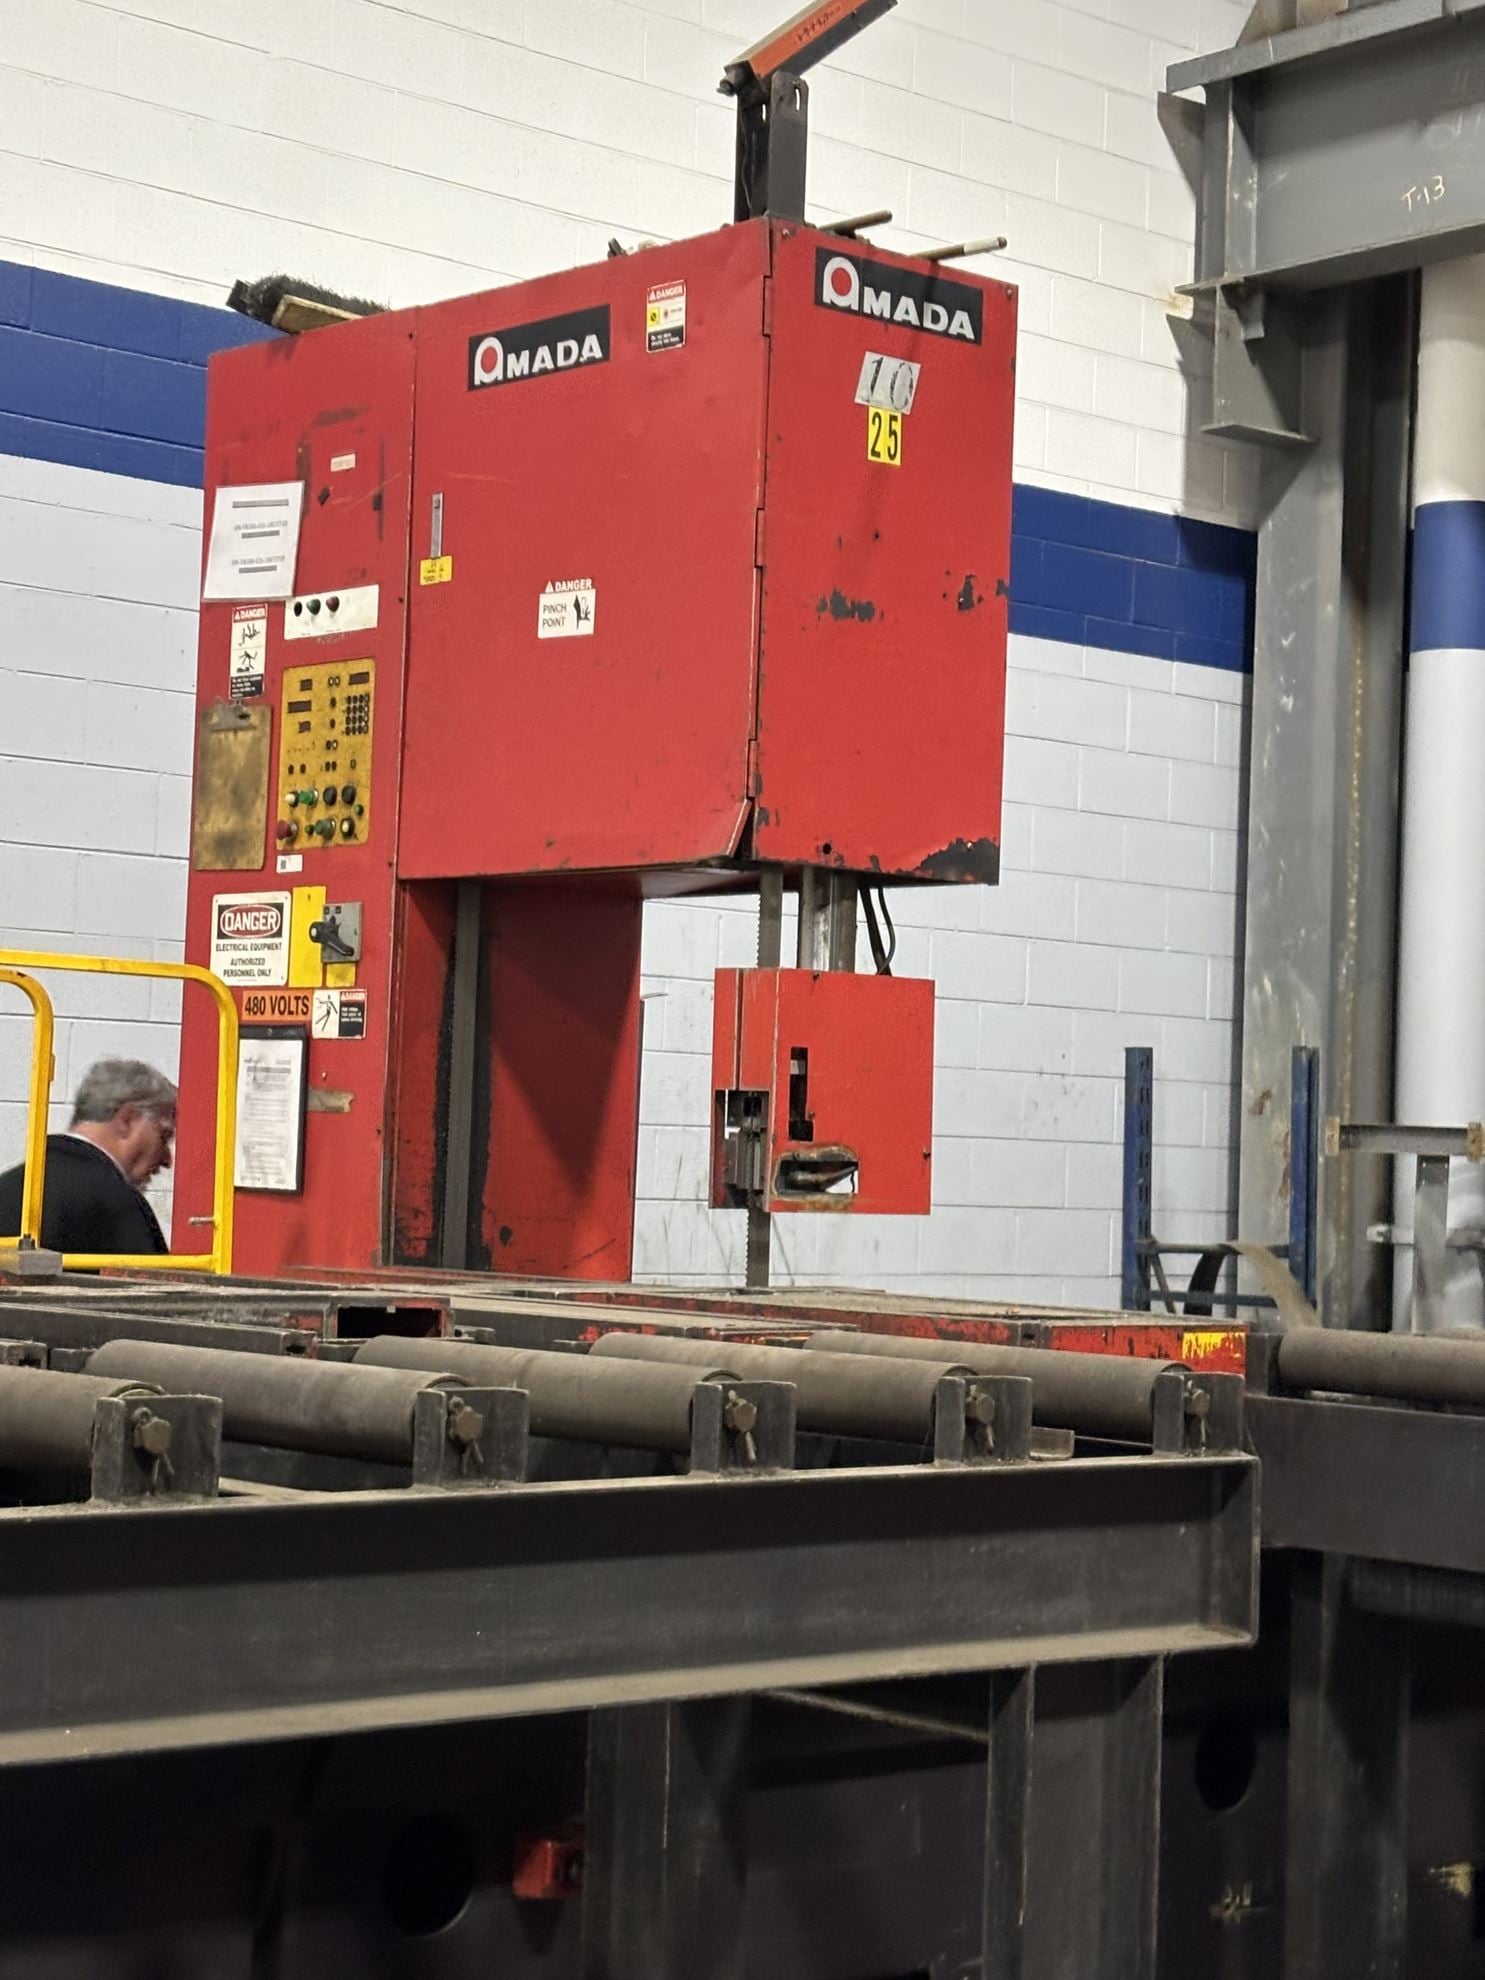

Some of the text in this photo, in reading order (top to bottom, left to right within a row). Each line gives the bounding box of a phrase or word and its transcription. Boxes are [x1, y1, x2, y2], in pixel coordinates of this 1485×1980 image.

[823, 256, 975, 340] AMADA
[474, 333, 603, 386] AMADA
[870, 356, 914, 411] 10
[870, 411, 899, 462] 25
[555, 578, 593, 593] DANGER
[542, 602, 567, 614] PINCH
[542, 616, 566, 628] POINT
[224, 911, 278, 932] DANGER
[215, 942, 282, 952] ELECTRICAL EQUIPMENT
[230, 957, 266, 967] AUTHORIZED
[223, 968, 272, 978] PERSONNEL ONLY
[244, 995, 310, 1016] 480 VOLTS
